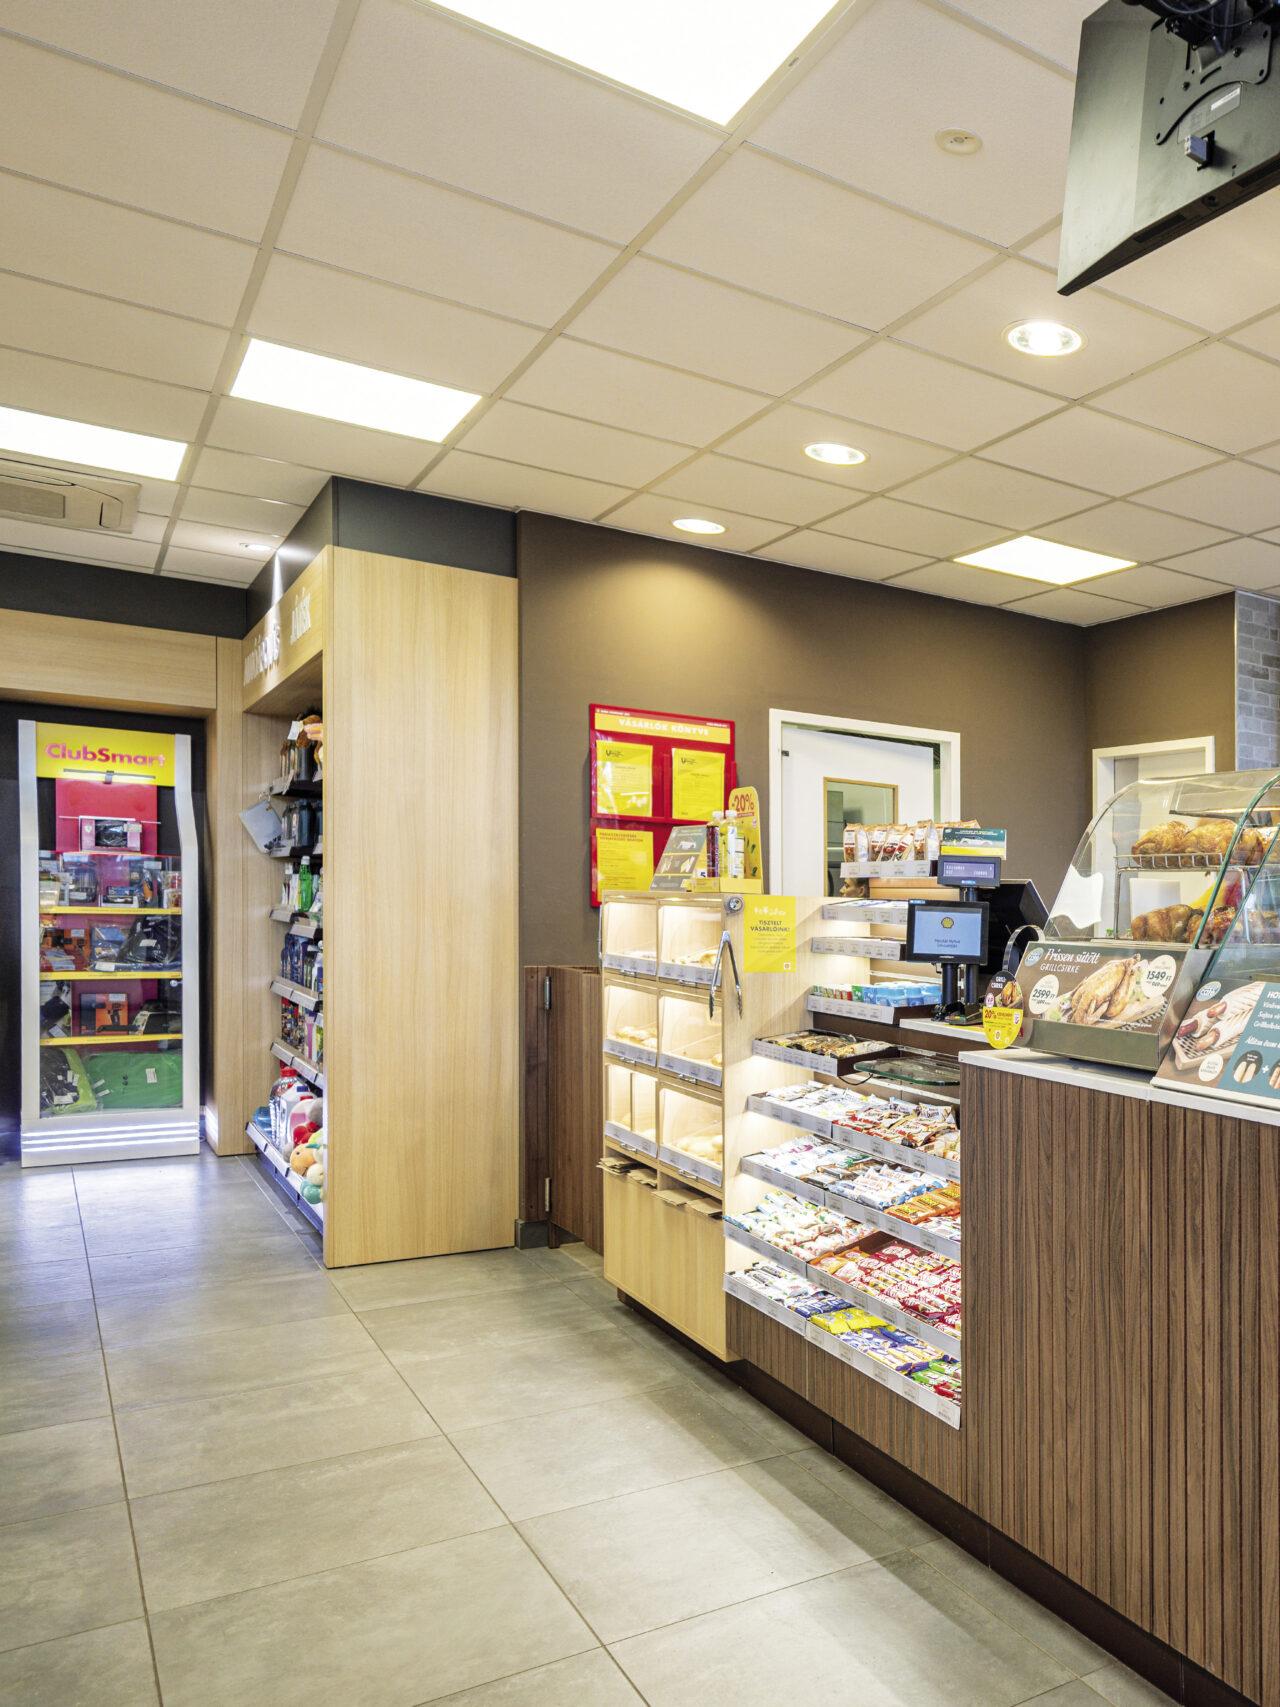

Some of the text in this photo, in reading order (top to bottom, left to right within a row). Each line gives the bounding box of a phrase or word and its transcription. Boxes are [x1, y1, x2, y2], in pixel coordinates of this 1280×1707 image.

[619, 719, 668, 731] VÁSÁRLÓK
[45, 743, 165, 768] ClubSmart
[1044, 948, 1075, 962] Frissen
[1040, 963, 1081, 974] GRILLCSIRKE
[1146, 970, 1166, 980] 1549
[1032, 988, 1051, 999] 2599
